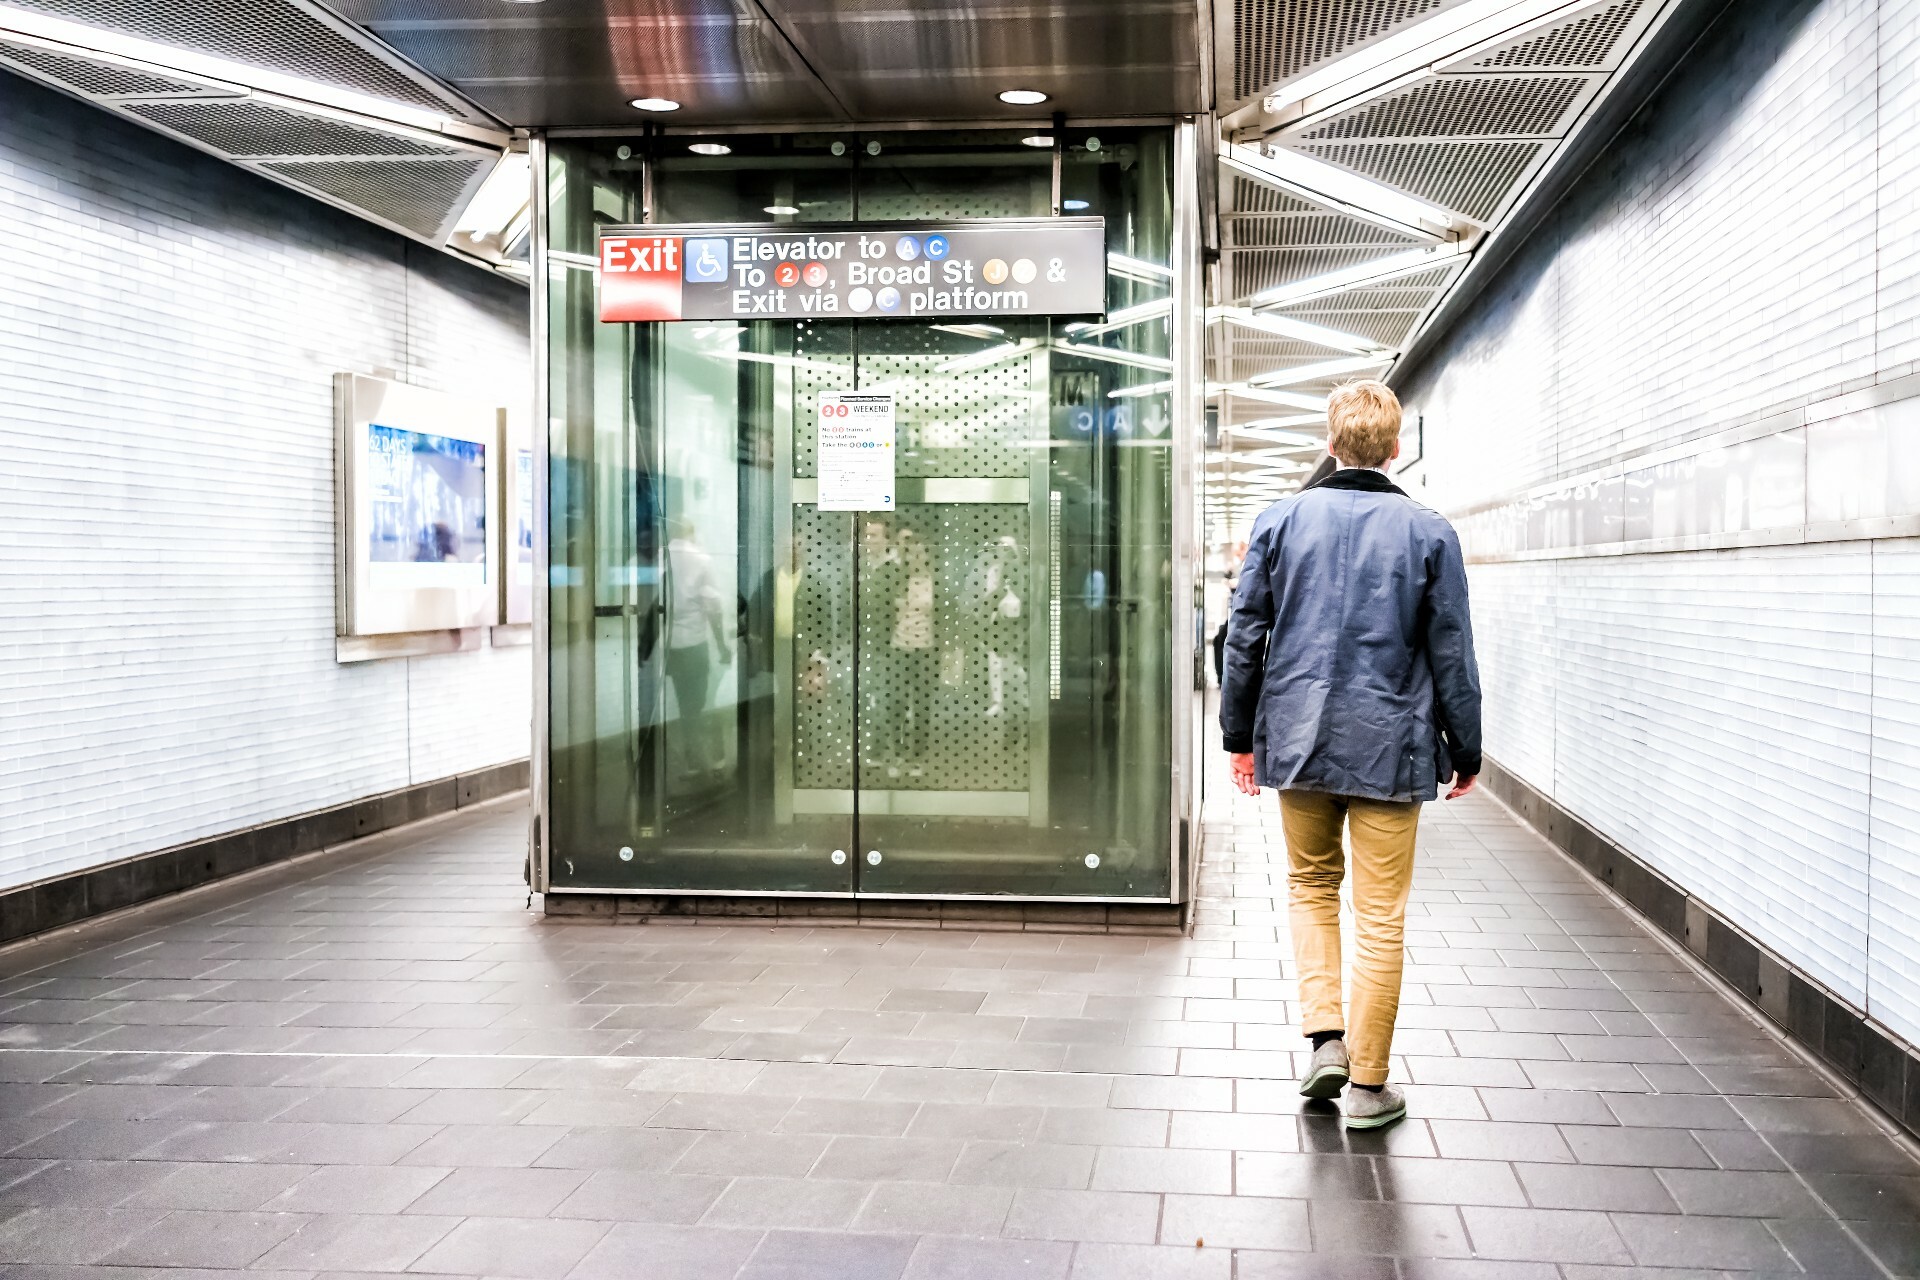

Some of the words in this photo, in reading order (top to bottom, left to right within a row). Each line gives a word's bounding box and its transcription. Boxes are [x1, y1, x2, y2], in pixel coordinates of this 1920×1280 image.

[603, 240, 678, 272] Exit
[733, 237, 845, 261] Elevator
[859, 236, 886, 259] to
[903, 240, 915, 256] A
[929, 240, 943, 256] C
[733, 264, 766, 287] To
[848, 260, 931, 285] Broad
[942, 259, 974, 284] St
[1046, 257, 1066, 283] &
[733, 290, 787, 314] Exit
[799, 289, 839, 312] via
[910, 287, 1028, 316] platform
[382, 435, 406, 455] DAYS
